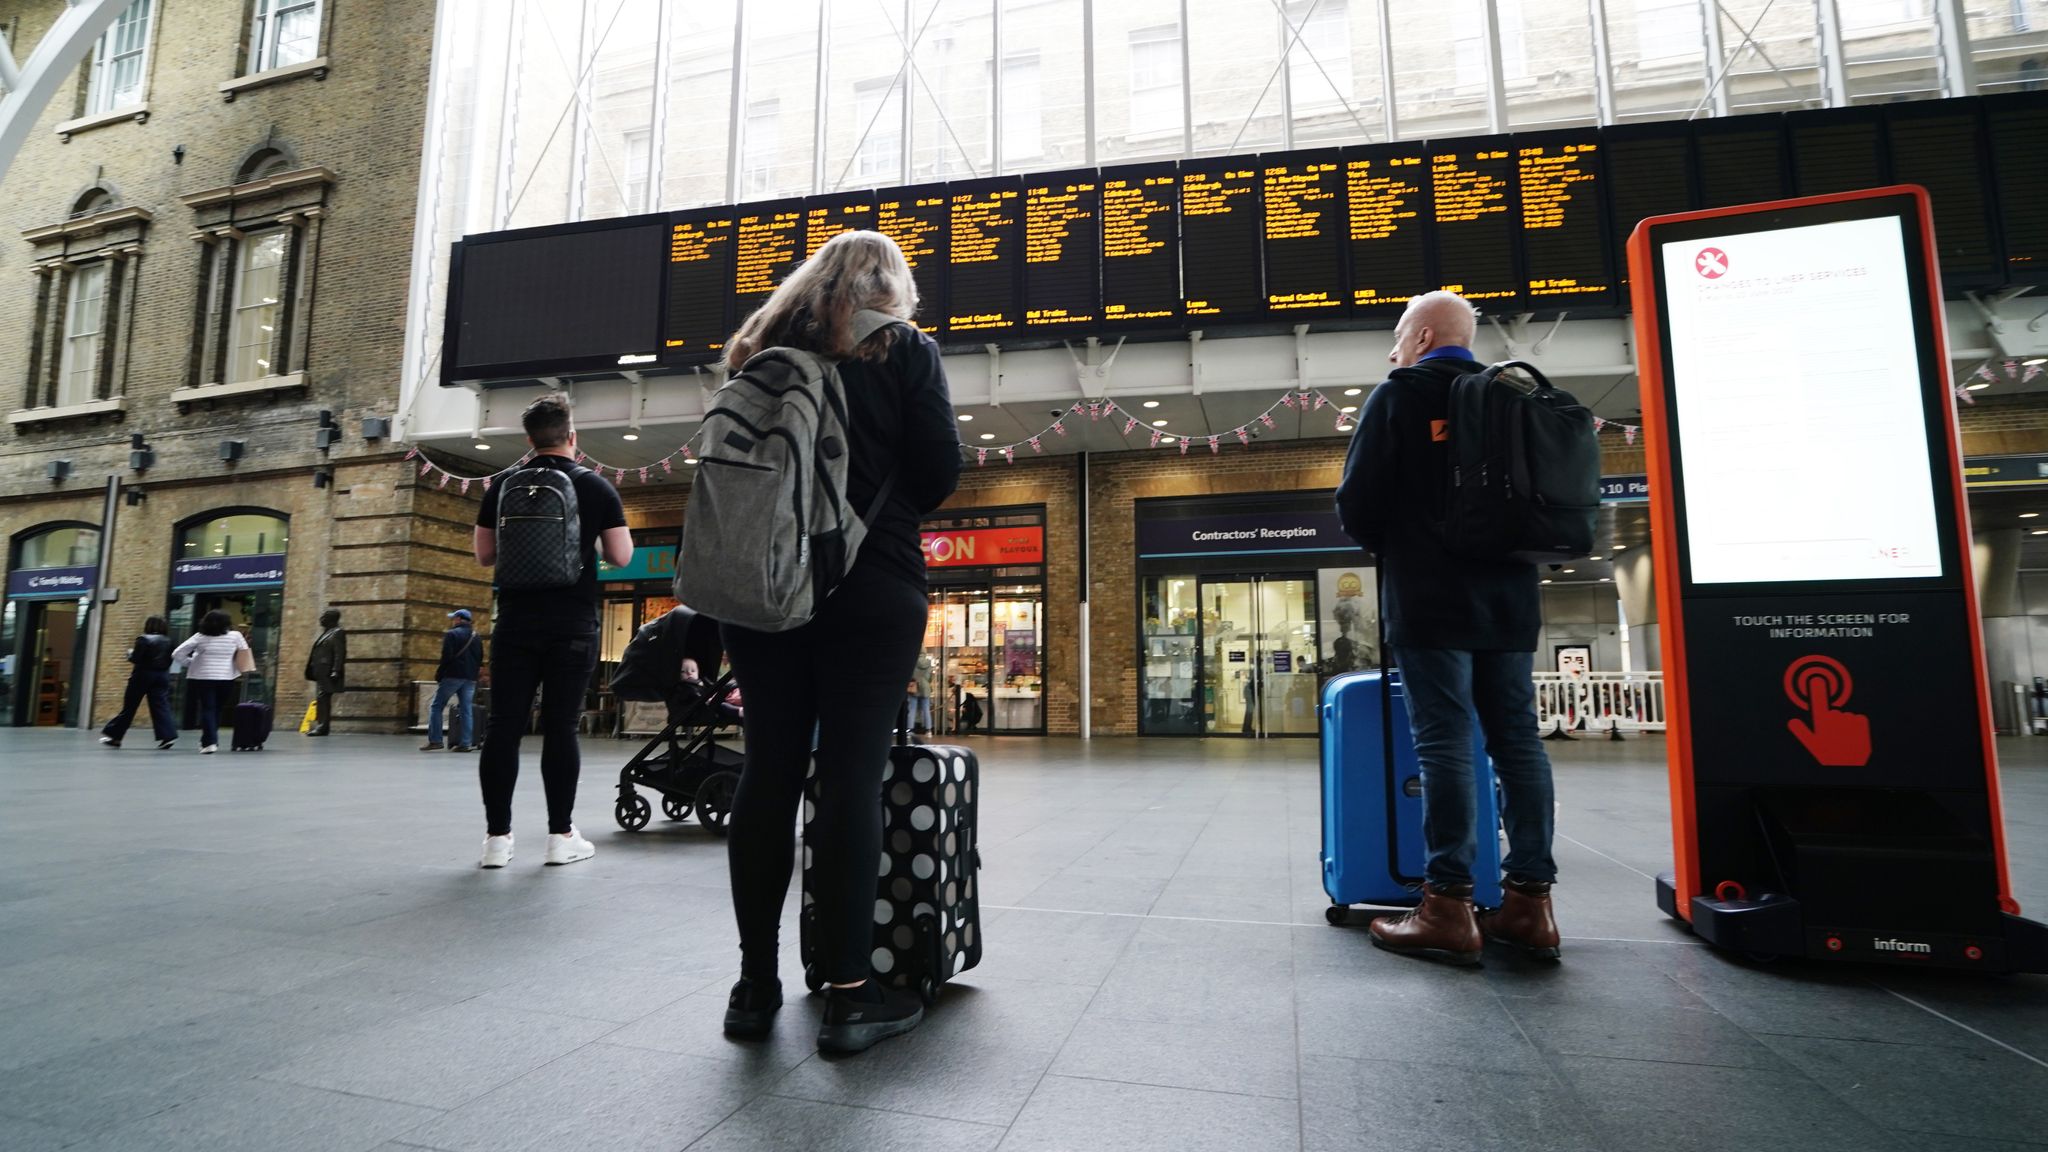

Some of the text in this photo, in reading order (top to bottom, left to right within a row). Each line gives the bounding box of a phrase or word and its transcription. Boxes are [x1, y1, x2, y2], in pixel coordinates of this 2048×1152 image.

[1607, 483, 1624, 494] 10
[1192, 526, 1316, 541] Contractors' Reception
[920, 536, 975, 562] EON
[1734, 612, 1910, 627] TOUCH THE SCREEN FOR
[1770, 627, 1873, 639] INFORMATION
[1874, 937, 1932, 954] inform
